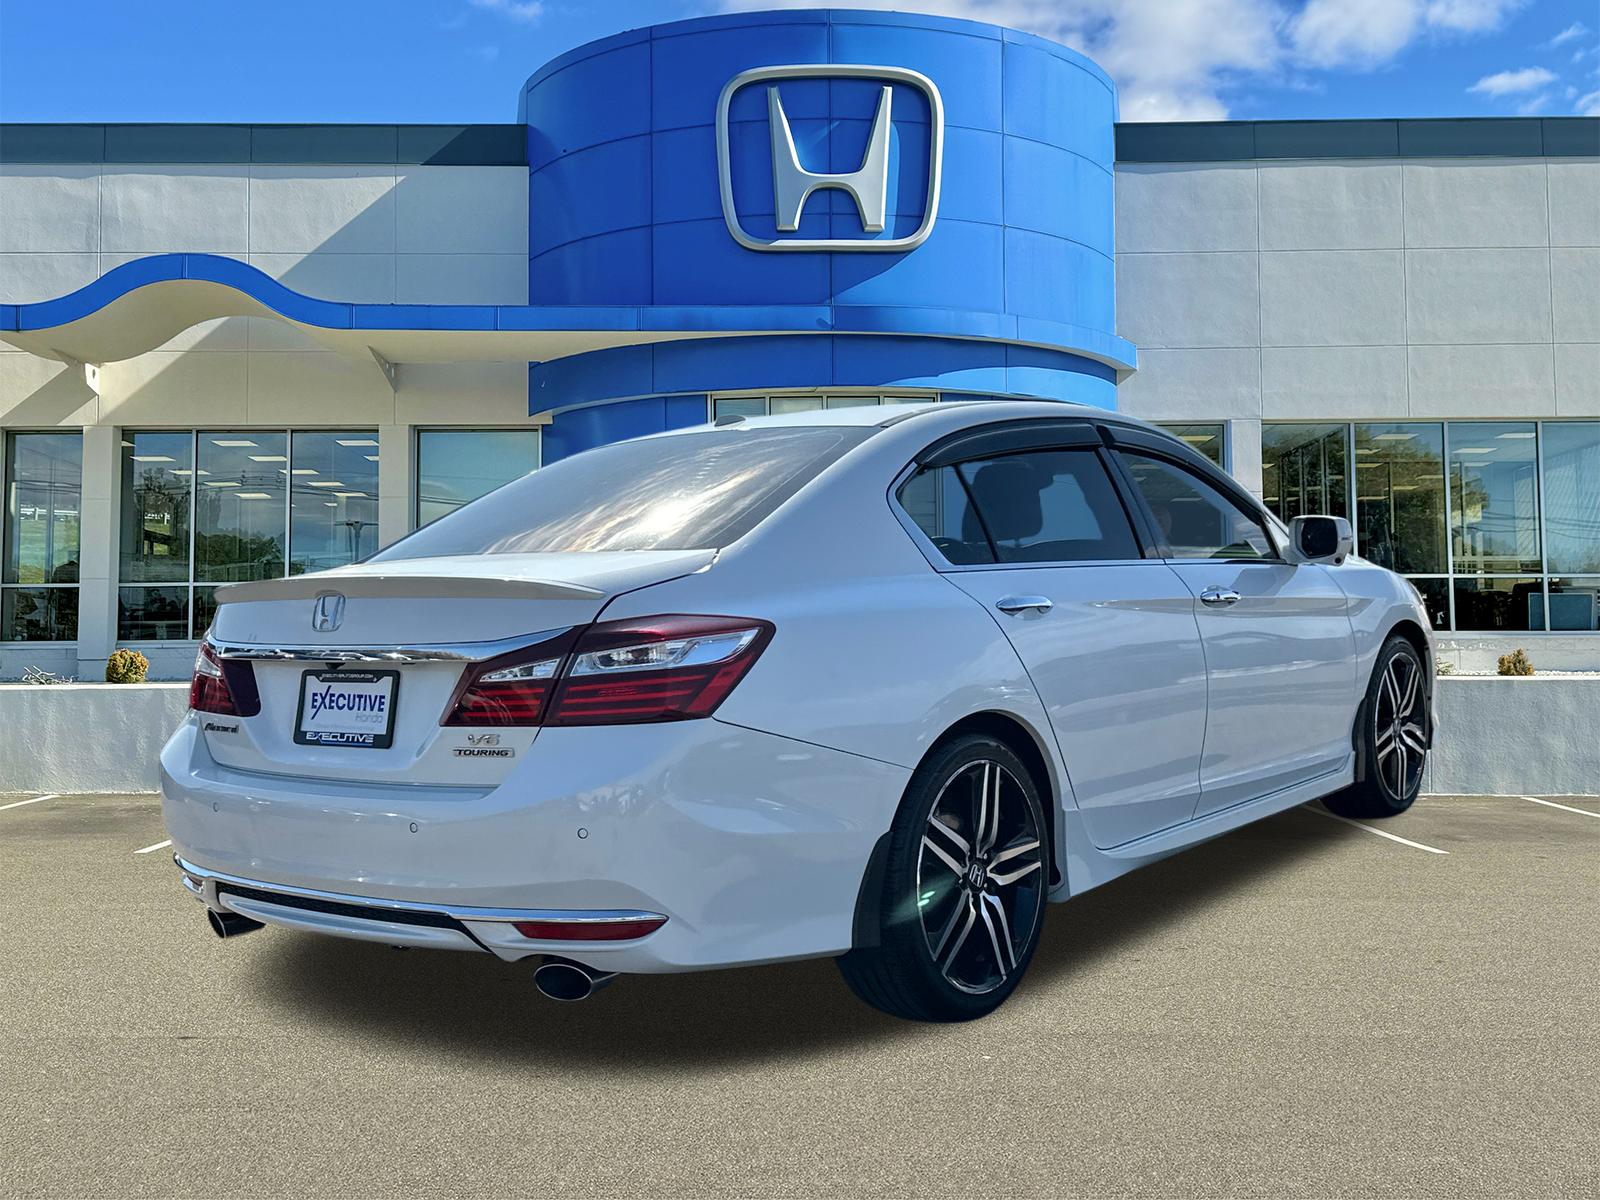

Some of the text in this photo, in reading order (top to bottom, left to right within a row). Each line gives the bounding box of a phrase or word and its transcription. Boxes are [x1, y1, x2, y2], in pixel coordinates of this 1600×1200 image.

[310, 687, 386, 718] EXECUTIVE
[305, 732, 374, 743] EXECUTIVE
[453, 748, 510, 757] TOURING
